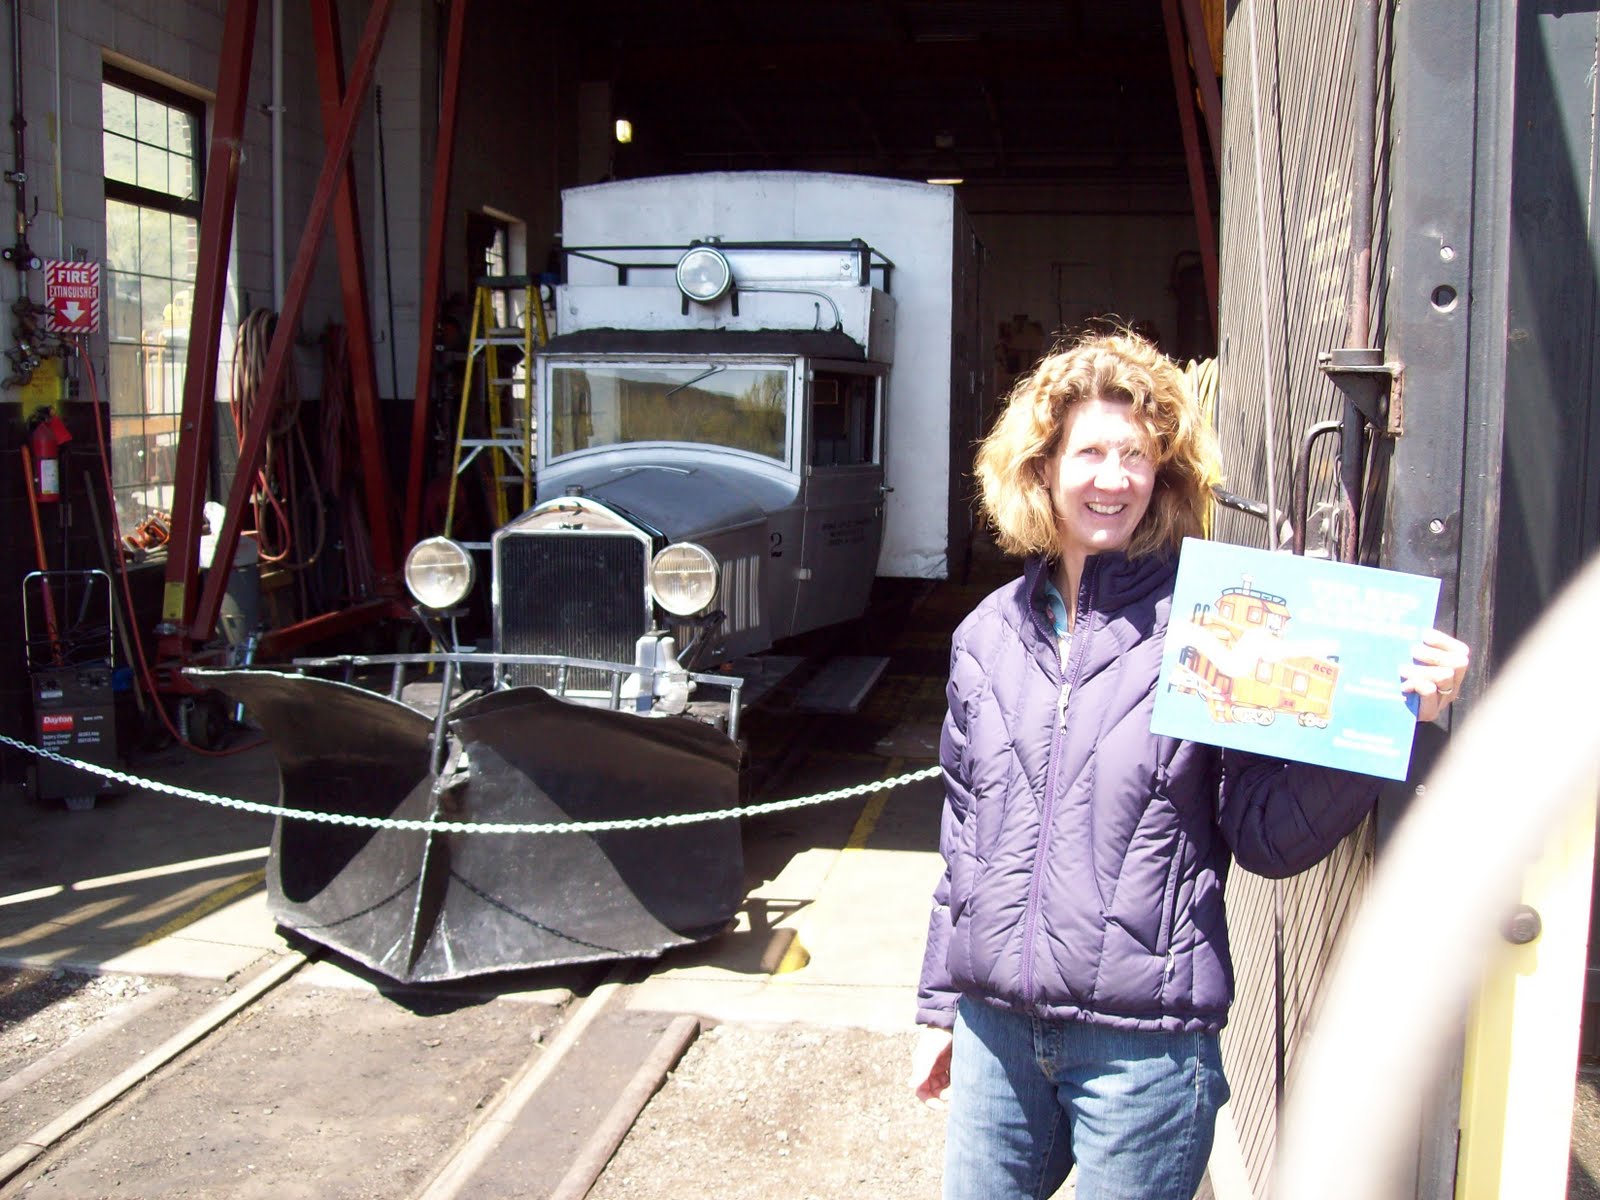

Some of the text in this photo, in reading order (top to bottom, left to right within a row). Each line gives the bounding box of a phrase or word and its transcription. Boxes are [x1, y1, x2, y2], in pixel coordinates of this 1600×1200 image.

[58, 270, 89, 283] FIRE
[49, 285, 97, 299] EXTINGUISHER
[770, 532, 783, 558] 2
[43, 716, 73, 724] Dayton
